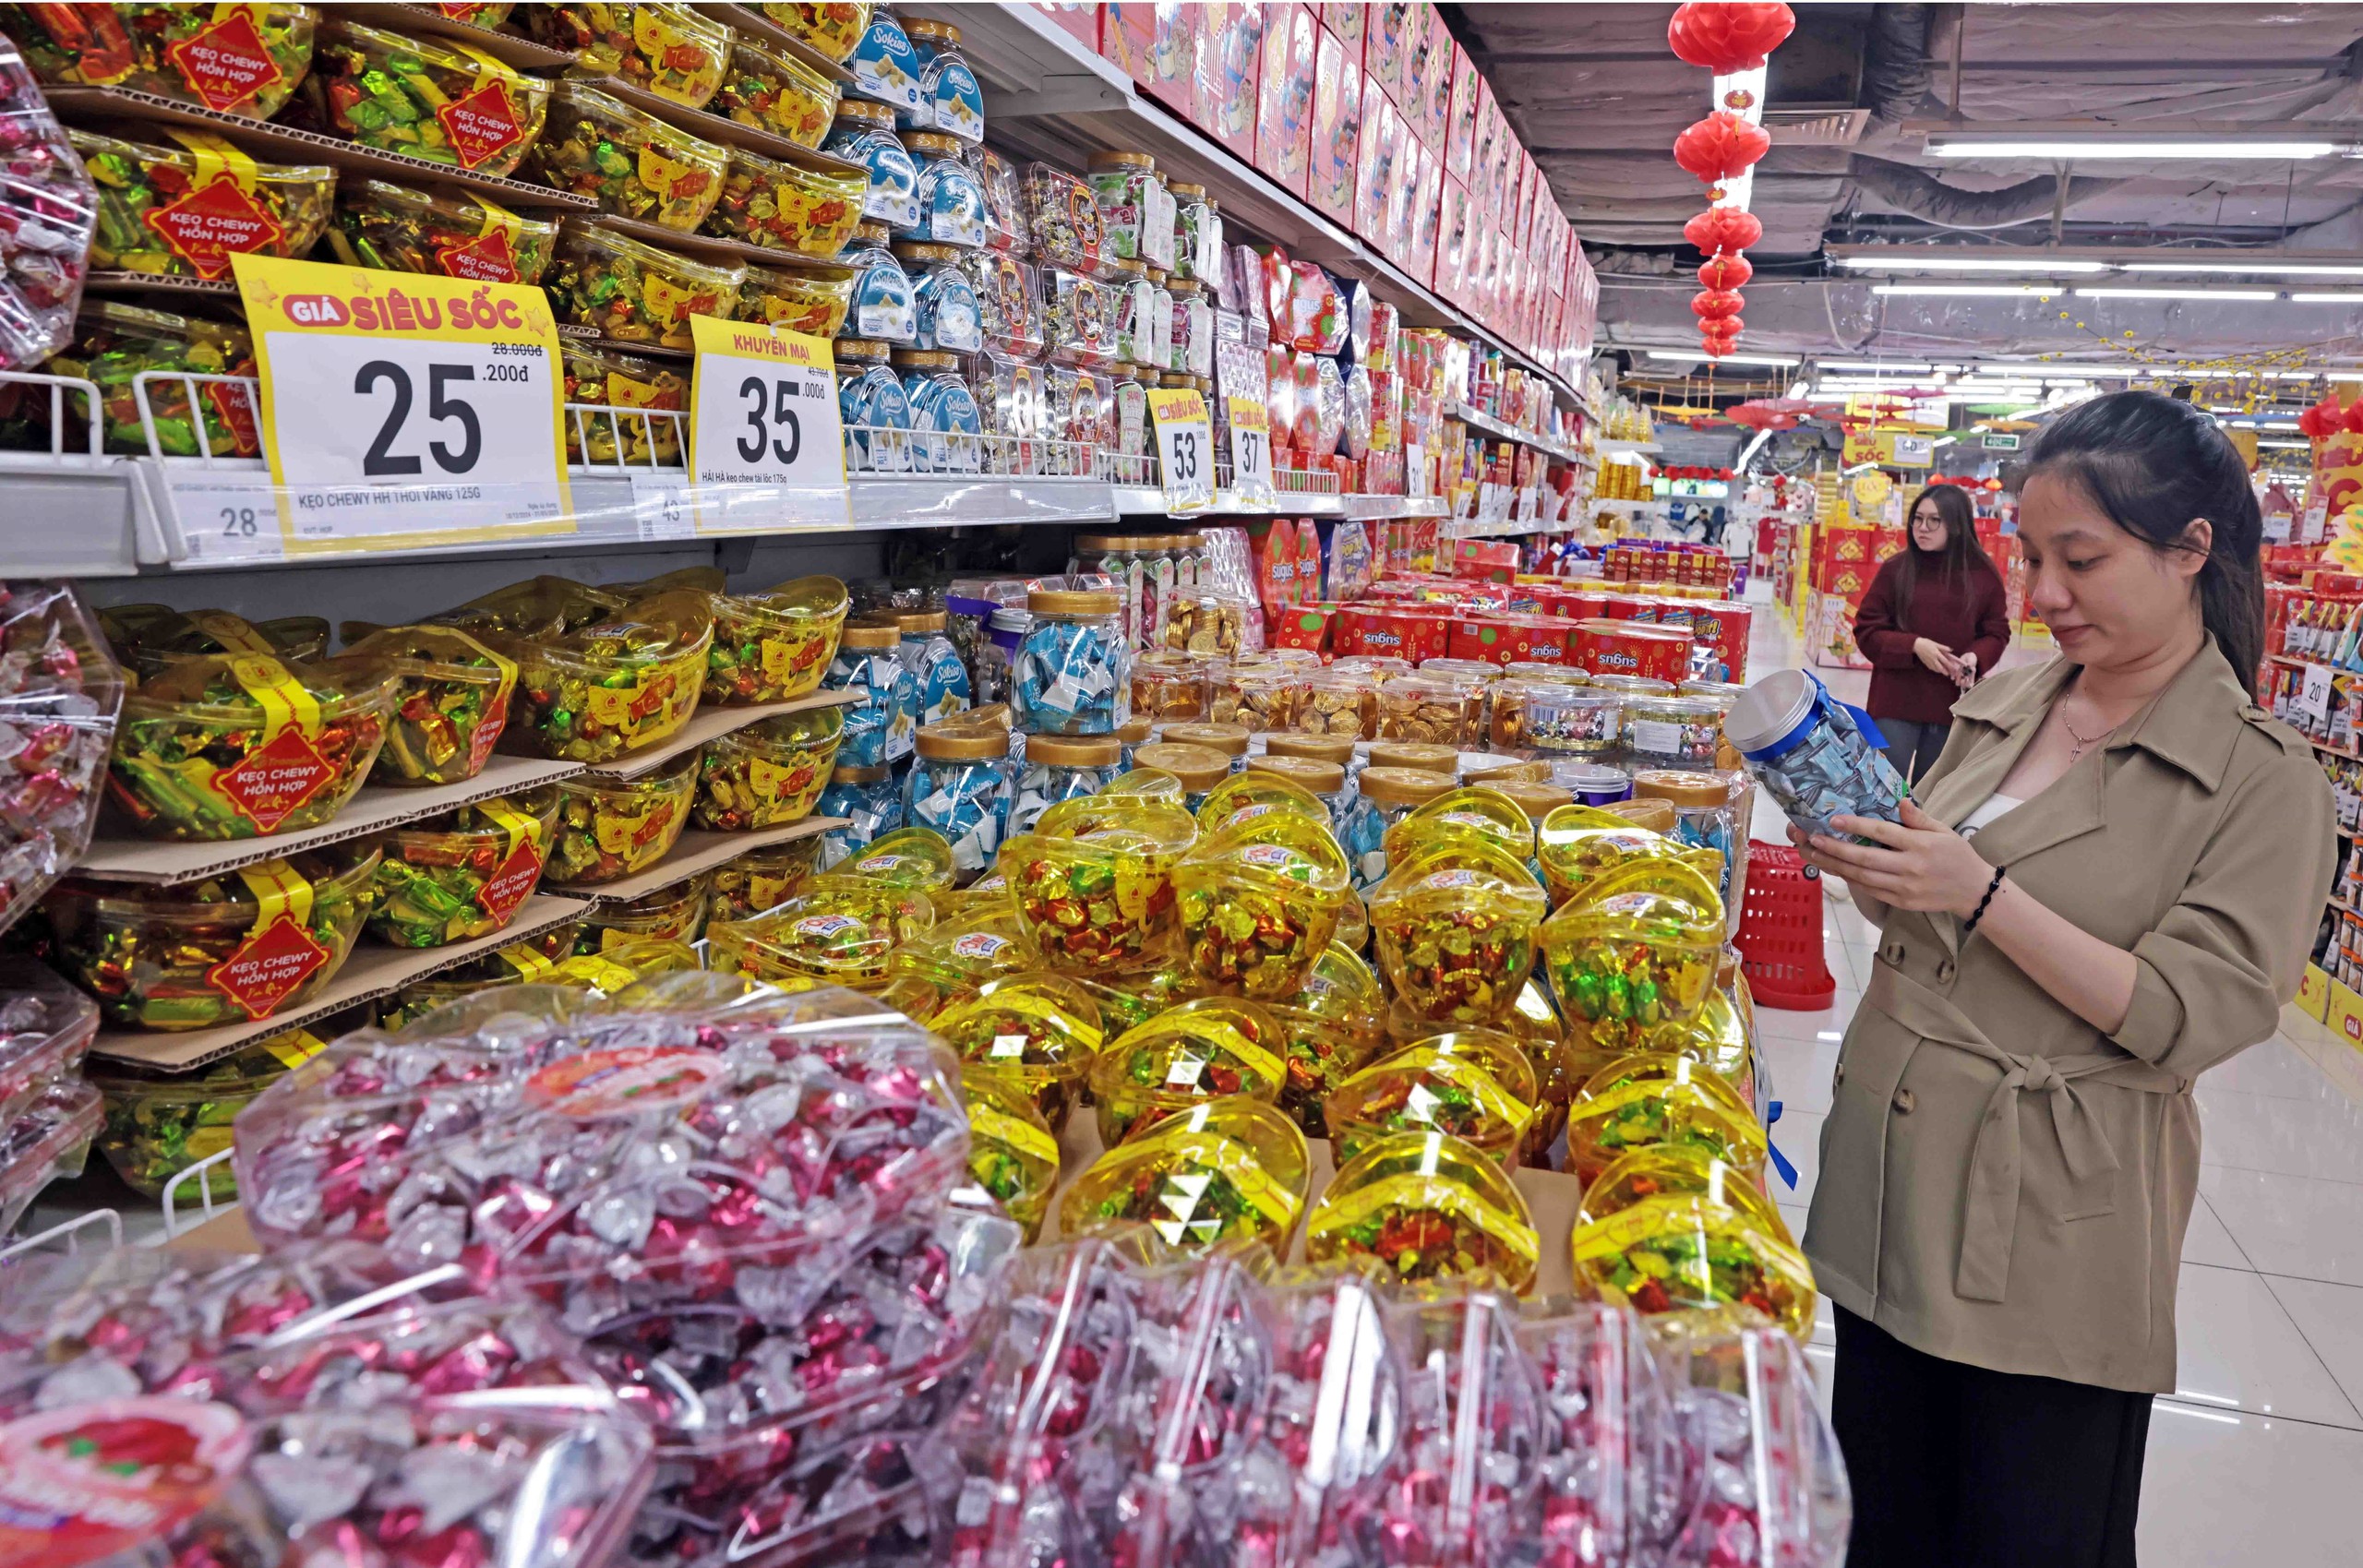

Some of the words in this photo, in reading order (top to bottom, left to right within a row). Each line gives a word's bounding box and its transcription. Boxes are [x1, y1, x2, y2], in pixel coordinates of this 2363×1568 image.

[873, 28, 909, 54] Sokiss
[221, 54, 267, 71] CHEWY
[948, 69, 975, 93] Sokiss
[455, 110, 475, 121] KẸO
[477, 116, 512, 132] CHEWY
[170, 212, 202, 224] KẸO
[206, 217, 261, 232] CHEWY
[478, 261, 510, 276] CHEWY
[292, 295, 341, 323] GIÁ
[350, 287, 442, 330] SIÊU
[450, 286, 522, 329] SỐC
[491, 342, 543, 356] 28.000đ
[733, 333, 787, 358] KHUYẾN
[790, 342, 810, 364] MẠI
[880, 391, 904, 412] Sokiss
[945, 397, 973, 416] Sokiss
[354, 360, 481, 475] 25
[482, 365, 529, 382] .200đ
[737, 377, 800, 464] 35
[803, 382, 825, 399] .000đ
[1174, 432, 1196, 480] 53
[1242, 431, 1258, 473] 37
[1855, 447, 1885, 461] SỐC
[702, 469, 714, 482] HẢI
[716, 470, 726, 483] HÀ
[738, 473, 754, 483] chew
[298, 494, 324, 510] KẸO
[327, 492, 370, 507] CHEWY
[373, 491, 390, 504] HH
[456, 486, 481, 499] 125G
[221, 508, 258, 536] 28
[1272, 563, 1293, 580] sugus
[1300, 559, 1316, 577] sugus
[1363, 632, 1401, 647] sugus
[1529, 644, 1562, 657] sugus
[1598, 652, 1638, 668] sugus
[937, 664, 961, 684] Sokiss
[2309, 682, 2321, 702] 20
[237, 771, 266, 784] KẸO
[270, 765, 319, 780] CHEWY
[231, 961, 258, 974] KẸO
[264, 952, 313, 968] CHEWY
[2346, 1019, 2359, 1036] GIÁ
